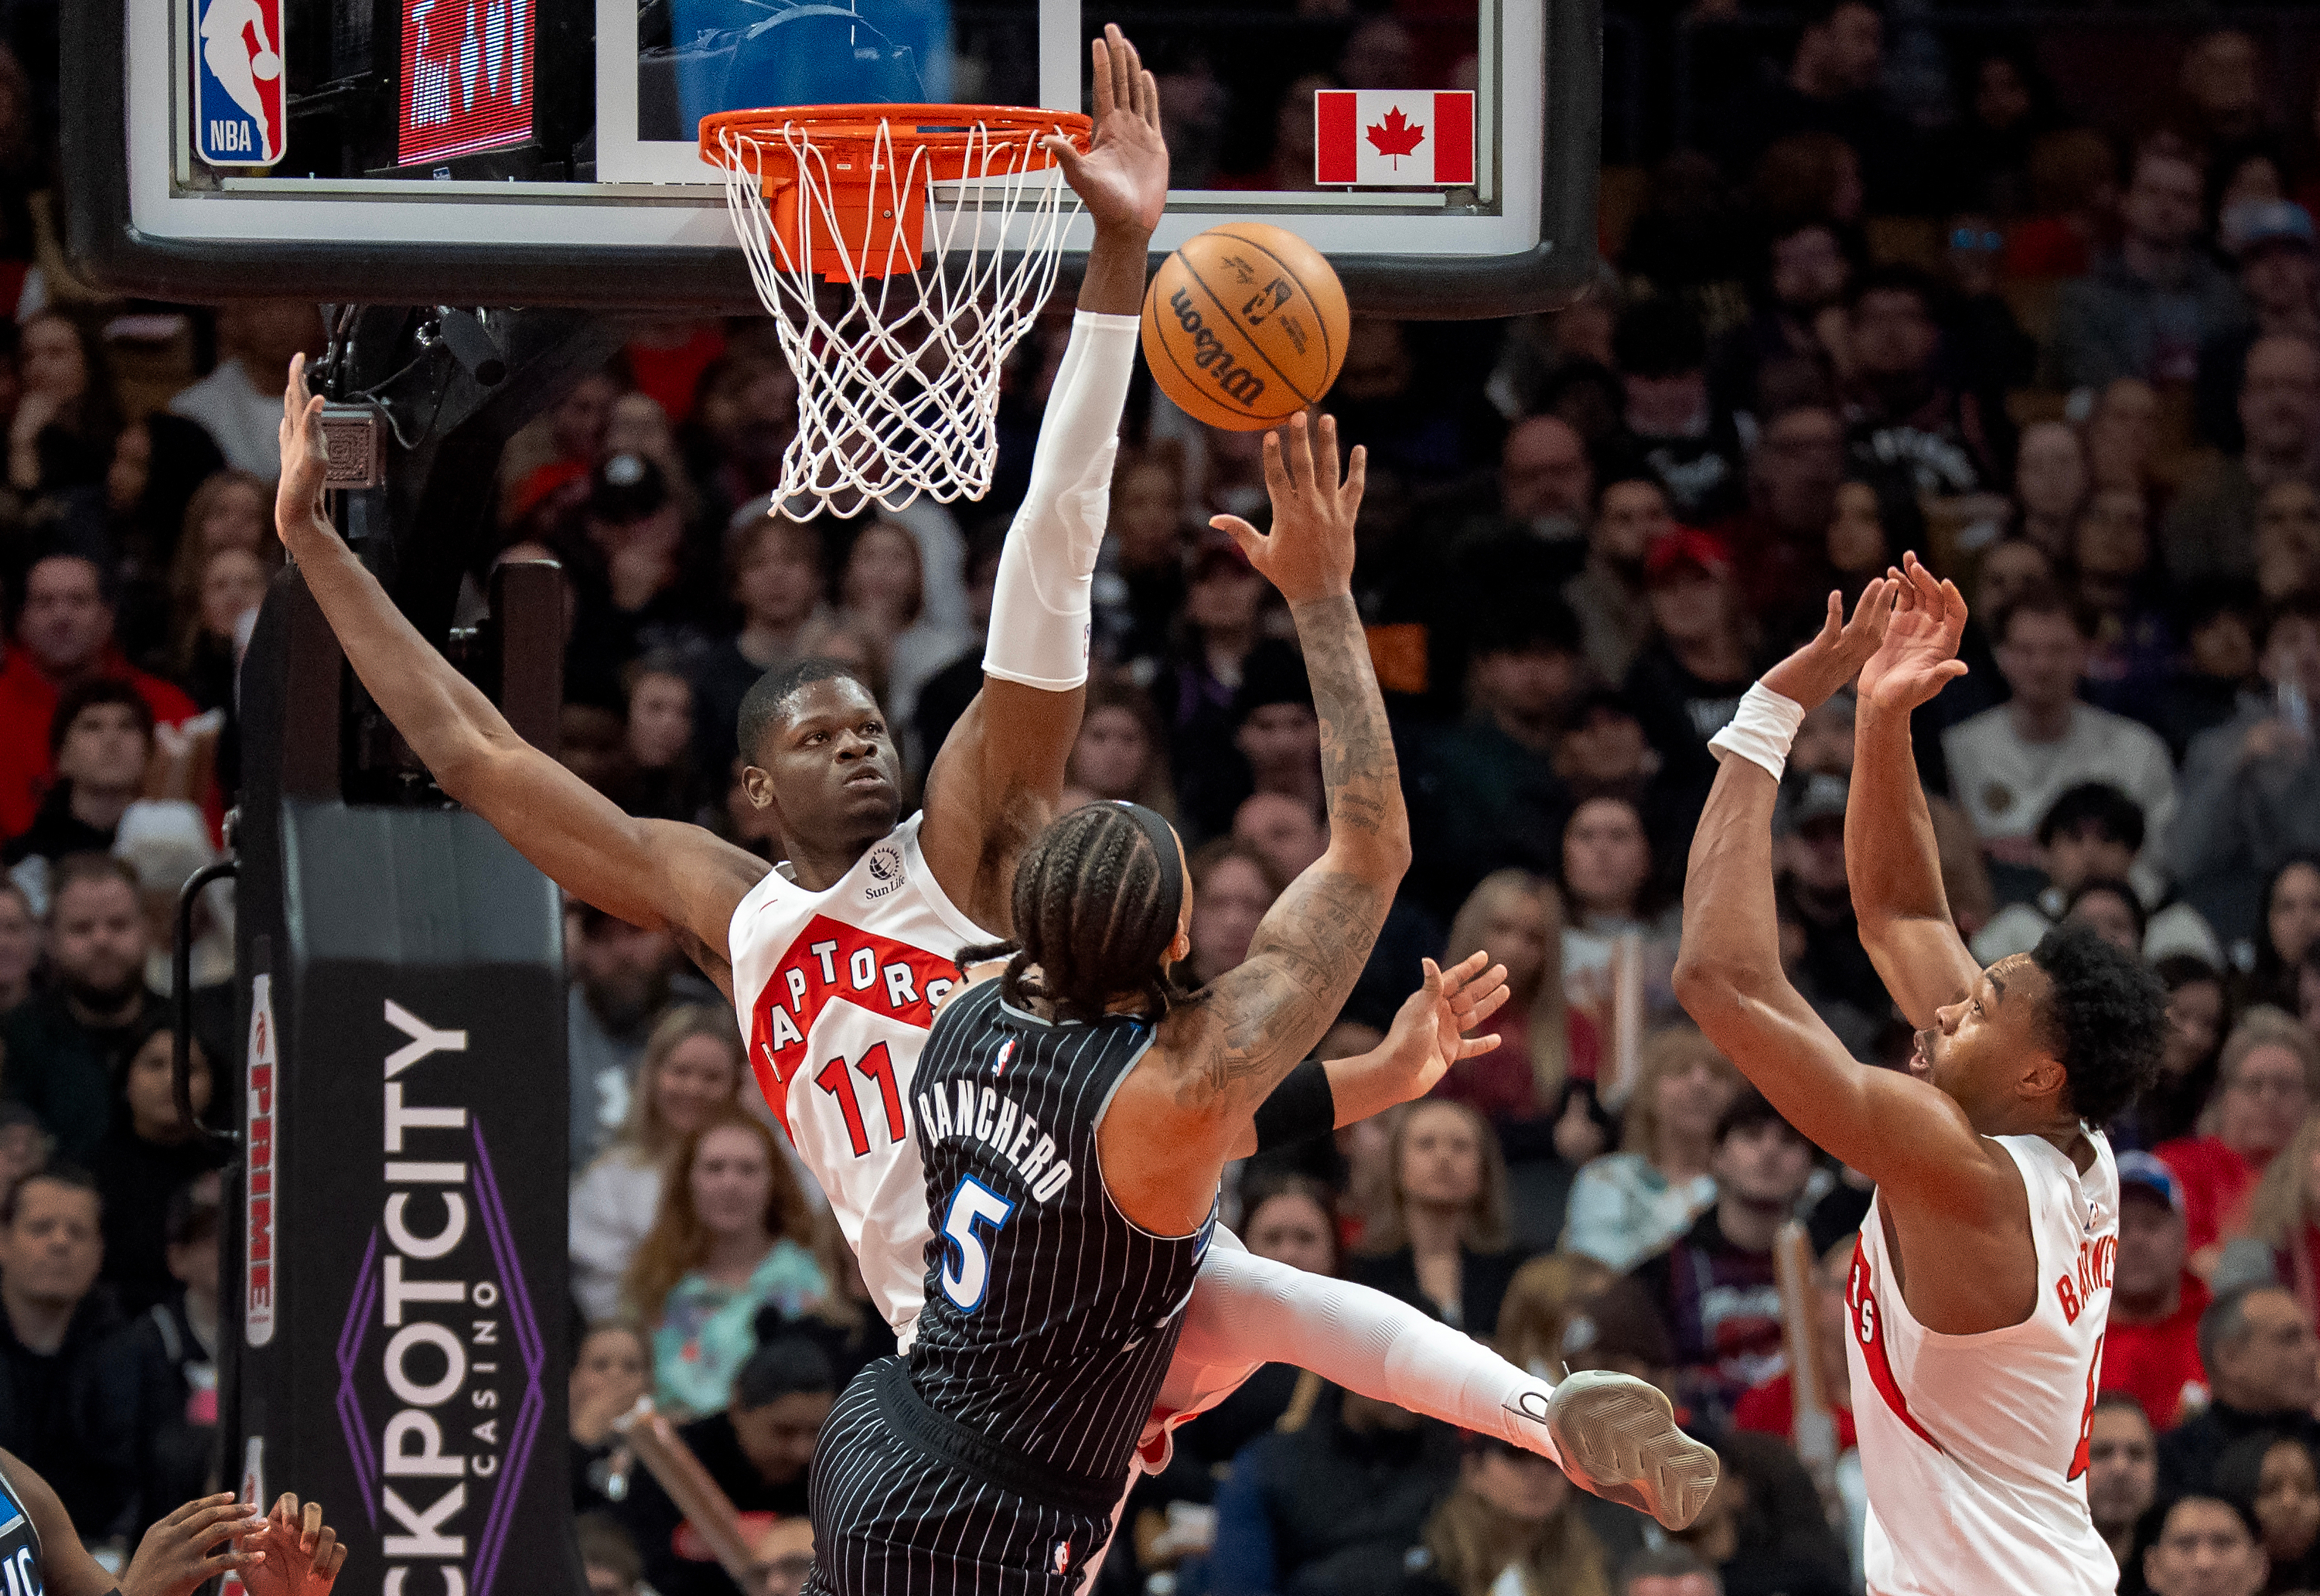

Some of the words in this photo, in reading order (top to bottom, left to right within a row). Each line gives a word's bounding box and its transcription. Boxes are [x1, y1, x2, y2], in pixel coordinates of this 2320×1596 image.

[210, 120, 252, 152] NBA
[1170, 286, 1265, 408] Wilson
[865, 886, 889, 900] Sun
[889, 875, 906, 892] Life
[762, 938, 954, 1083] APTORS
[814, 1040, 906, 1158] 11
[918, 1079, 1073, 1203] BANCHERO
[250, 1062, 272, 1310] PRIME
[941, 1171, 1016, 1314] 5
[2056, 1234, 2118, 1326] BARNE
[472, 1281, 500, 1478] CASINO
